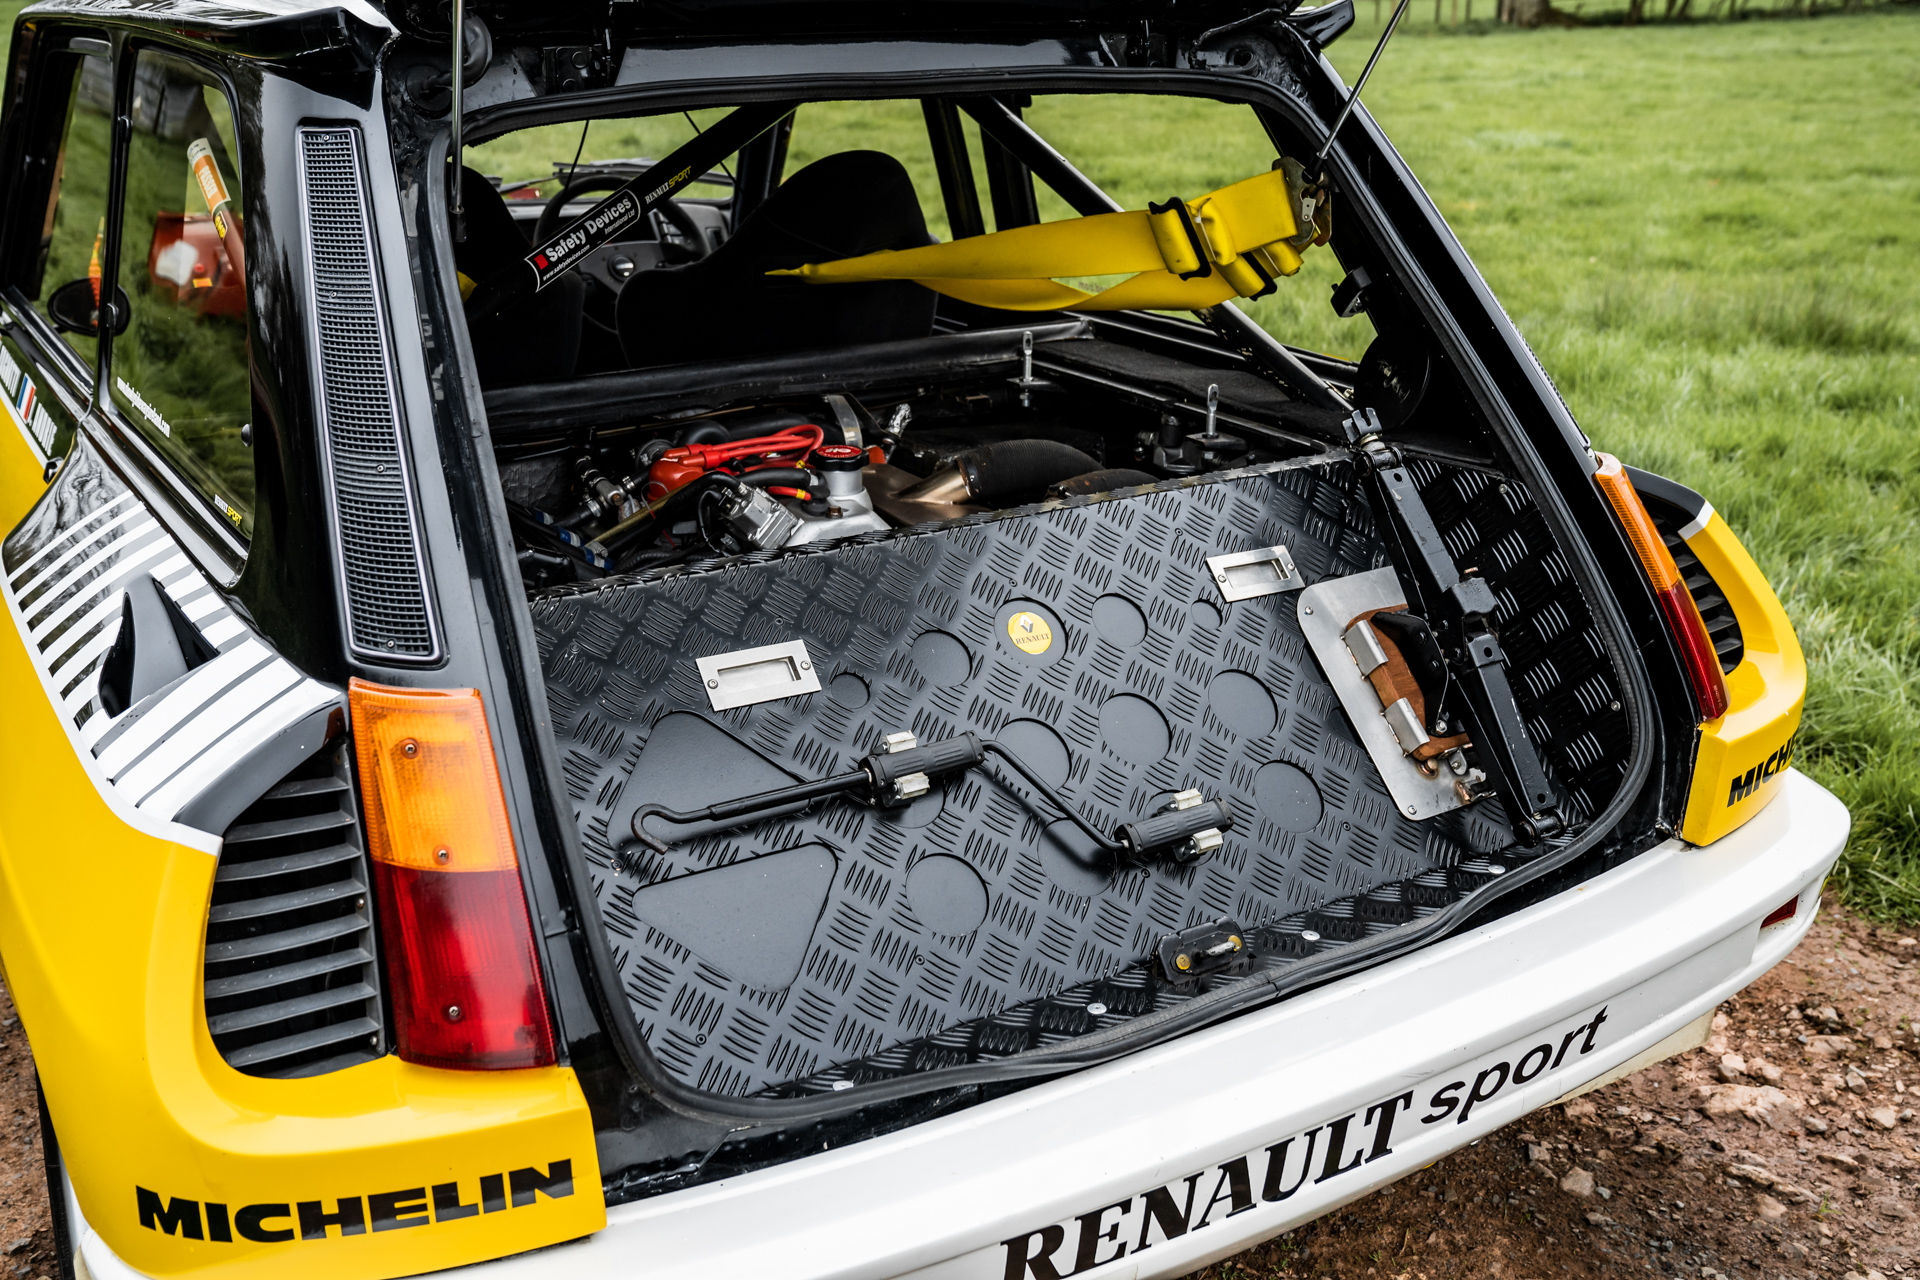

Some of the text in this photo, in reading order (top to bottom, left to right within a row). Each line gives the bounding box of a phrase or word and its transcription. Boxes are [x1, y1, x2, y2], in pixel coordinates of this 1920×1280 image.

[645, 165, 691, 204] RENAULT SPORT
[545, 198, 632, 262] Safety Devices
[1015, 633, 1051, 645] RENAULT
[1000, 1005, 1608, 1280] RENAULT sport
[136, 1158, 575, 1243] MICHELIN
